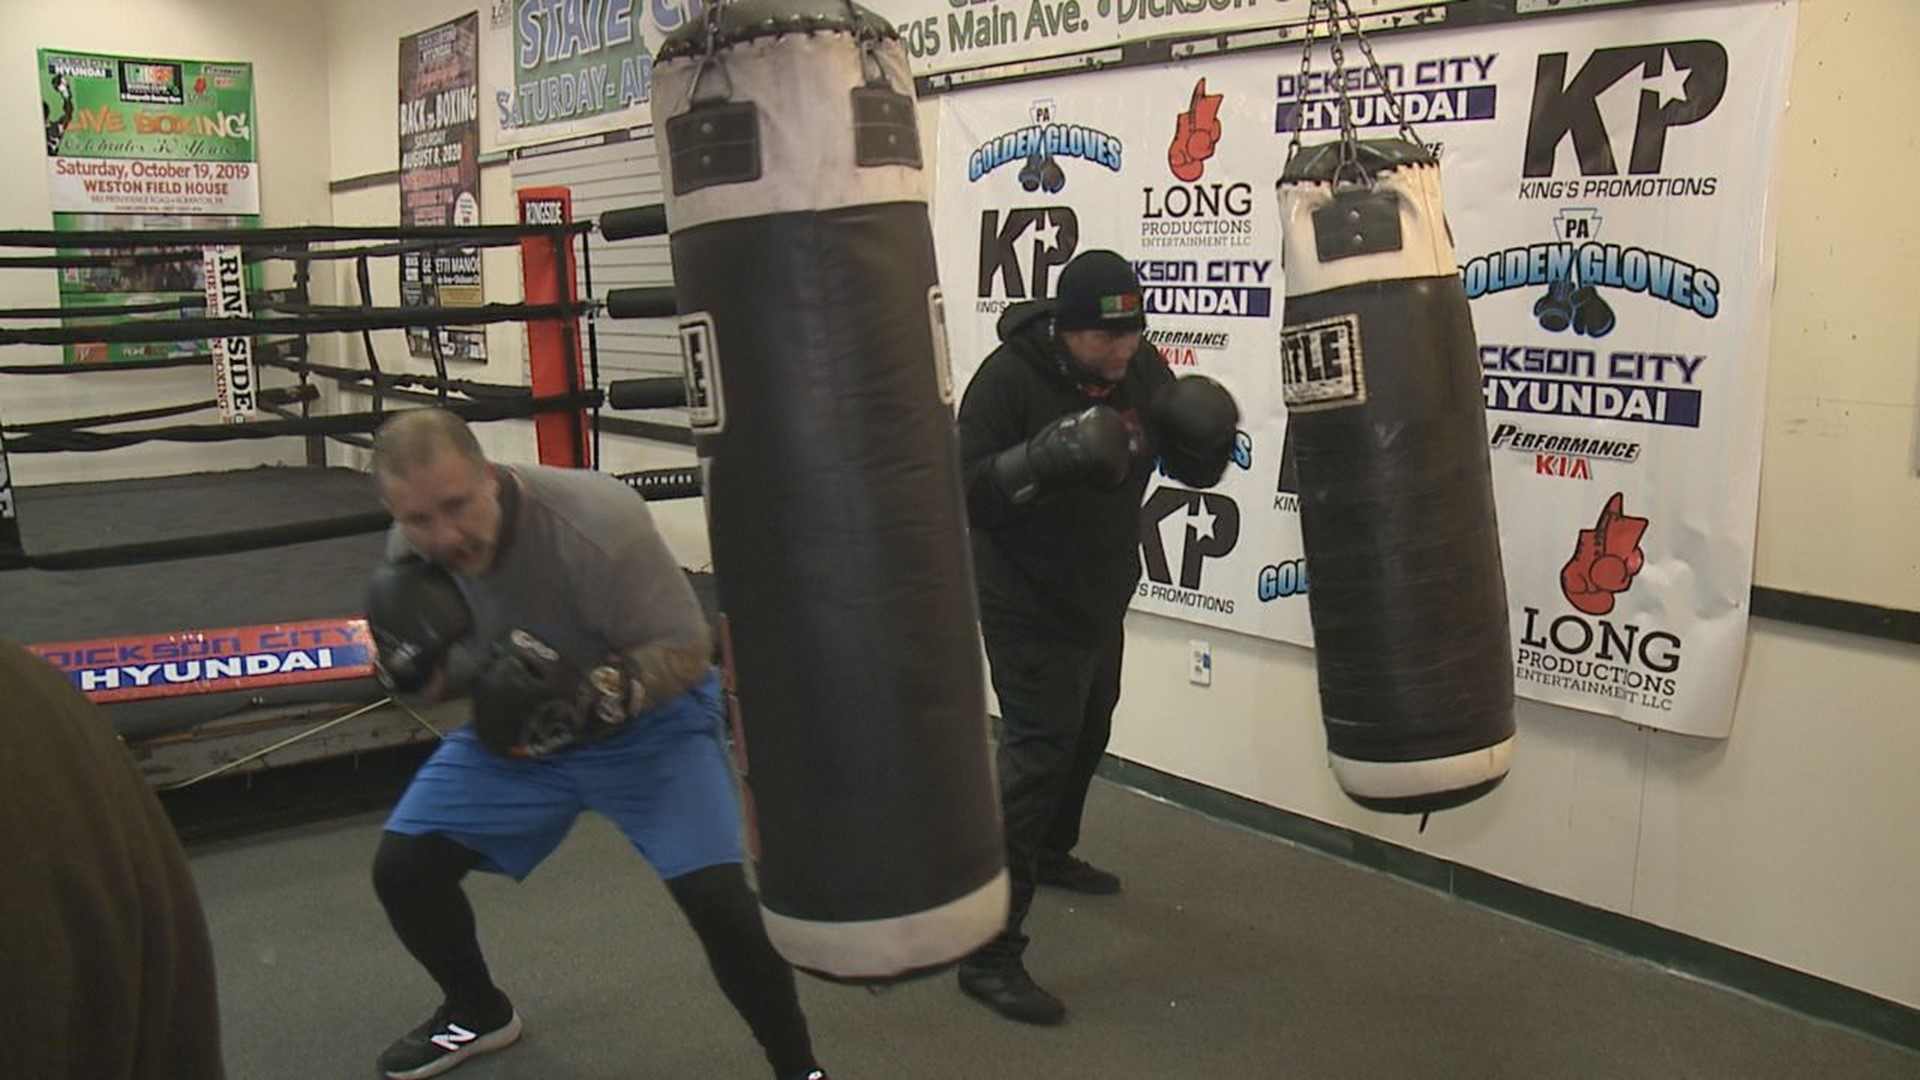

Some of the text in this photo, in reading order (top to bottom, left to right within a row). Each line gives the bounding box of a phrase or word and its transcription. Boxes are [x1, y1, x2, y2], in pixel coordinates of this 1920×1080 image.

[899, 17, 941, 58] 505
[948, 5, 1017, 52] Main
[1024, 0, 1089, 41] Ave.
[620, 55, 652, 109] AP
[1415, 54, 1498, 86] CITY
[63, 105, 250, 141] LIVE BOXING
[401, 98, 426, 136] BACK
[436, 85, 477, 128] BOXING
[1036, 107, 1050, 123] PA
[1302, 90, 1467, 130] HYUNDAI
[1522, 39, 1729, 178] KP
[968, 124, 1123, 183] GOLDEN GLOVES
[56, 160, 250, 181] Saturday, October 19, 2019
[84, 180, 229, 195] WESTON FIELD HOUSE
[1142, 183, 1252, 220] LONG
[1519, 176, 1718, 200] KING'S PROMOTIONS
[525, 201, 563, 226] RINGSIDE
[1141, 219, 1252, 236] PRODUCTIONS
[1564, 218, 1590, 240] PA
[1141, 235, 1252, 248] ENTERTAINMENT LLC
[1133, 260, 1273, 283] KSON CITY
[1459, 241, 1721, 319] OLDEN GLOVES
[1142, 286, 1249, 316] YUNDAI
[219, 256, 253, 411] RINSIDE
[1145, 330, 1229, 347] RFORMANCE
[1479, 345, 1707, 384] CKSON CITY
[1483, 378, 1668, 421] HYUNDAI
[1490, 423, 1641, 459] PERFORMANCE
[627, 473, 693, 487] REATNESS
[1535, 453, 1592, 481] KIA
[1273, 495, 1300, 513] KIN
[1258, 558, 1309, 603] GOL
[1150, 585, 1236, 615] PROMOTIONS
[258, 626, 359, 649] CITY
[1520, 606, 1681, 673] LONG
[80, 647, 334, 691] HYUNDAI
[1517, 648, 1677, 696] PRODUCTIONS
[1641, 694, 1674, 712] LLC
